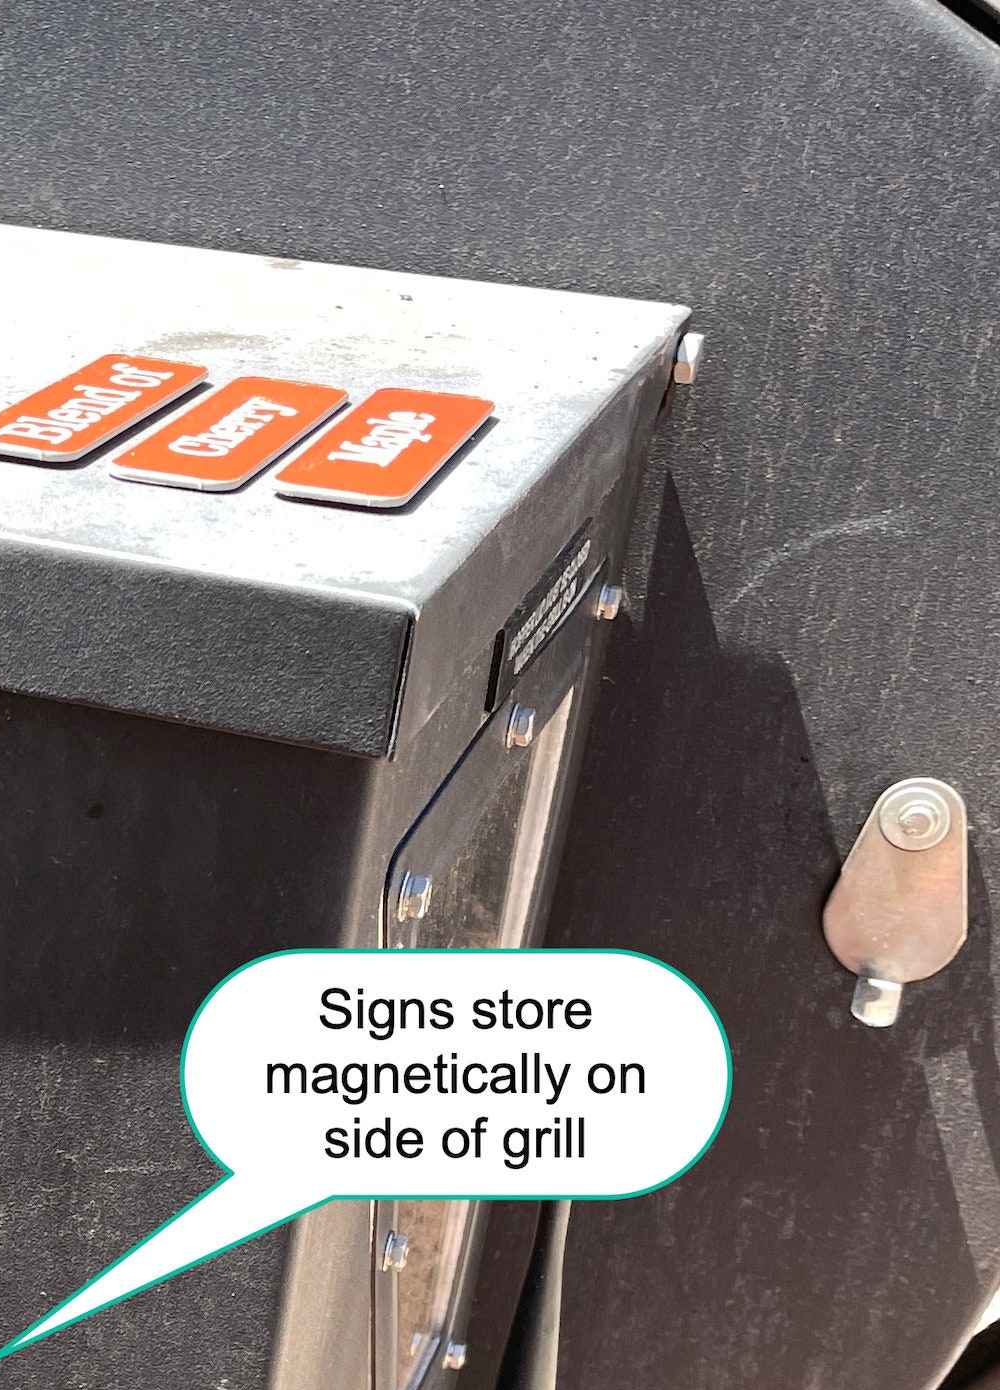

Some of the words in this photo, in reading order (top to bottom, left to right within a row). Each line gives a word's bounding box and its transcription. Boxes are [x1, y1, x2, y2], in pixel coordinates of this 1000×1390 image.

[123, 362, 175, 391] of
[168, 395, 299, 458] Cherry
[326, 410, 436, 467] Maple
